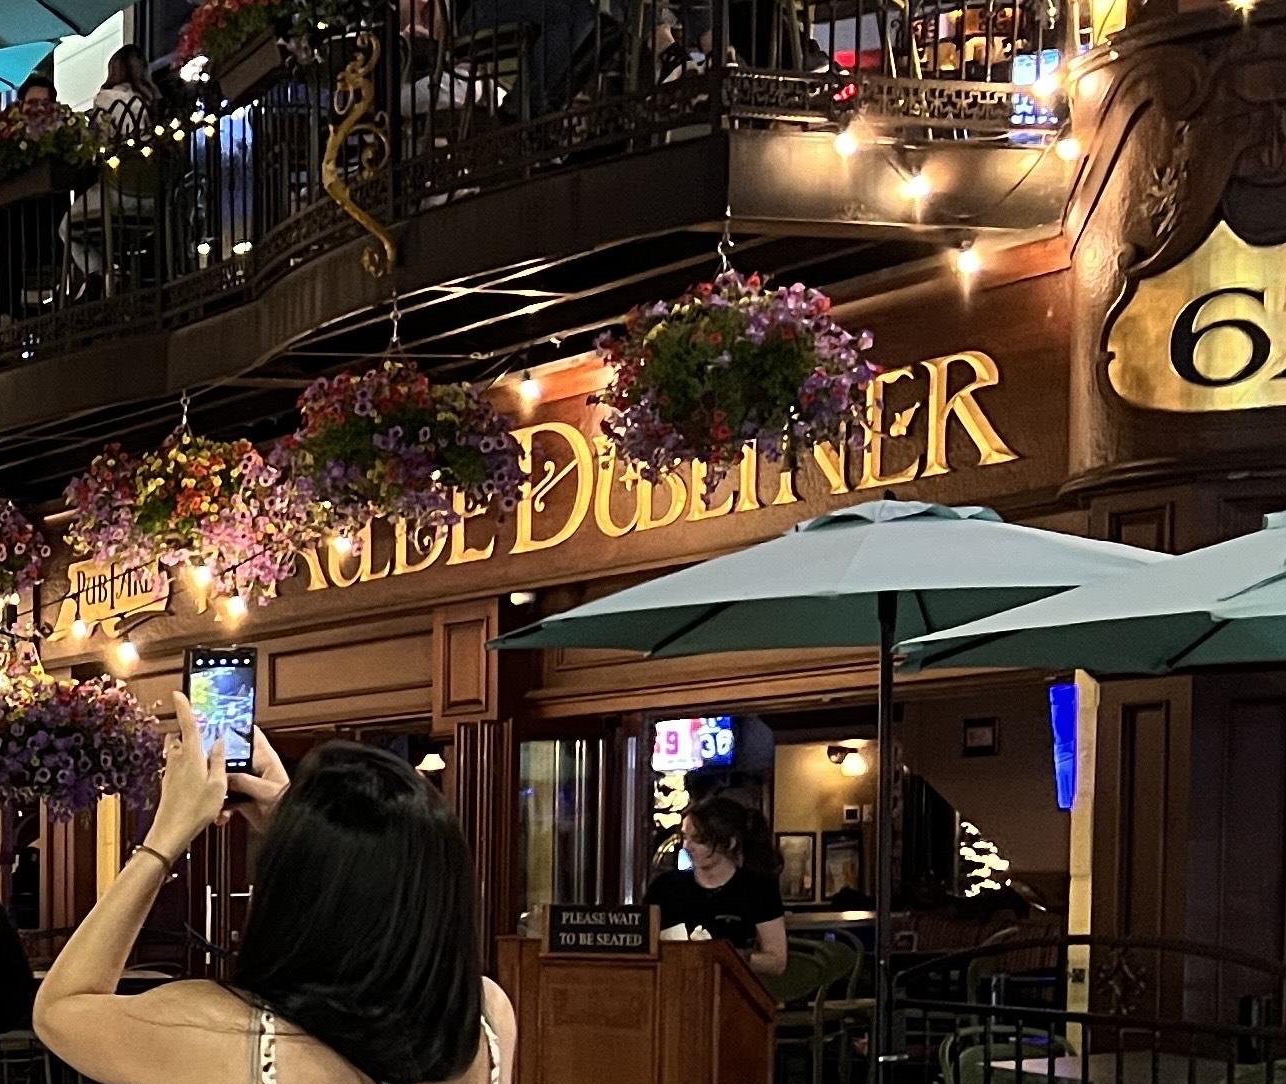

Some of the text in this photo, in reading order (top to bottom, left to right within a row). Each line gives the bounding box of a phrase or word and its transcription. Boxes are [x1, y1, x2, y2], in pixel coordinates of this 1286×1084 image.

[1171, 288, 1286, 387] 6
[77, 570, 108, 606] PUB
[561, 911, 642, 926] PLEASE WAIT
[559, 932, 643, 947] TO BE SEATED
